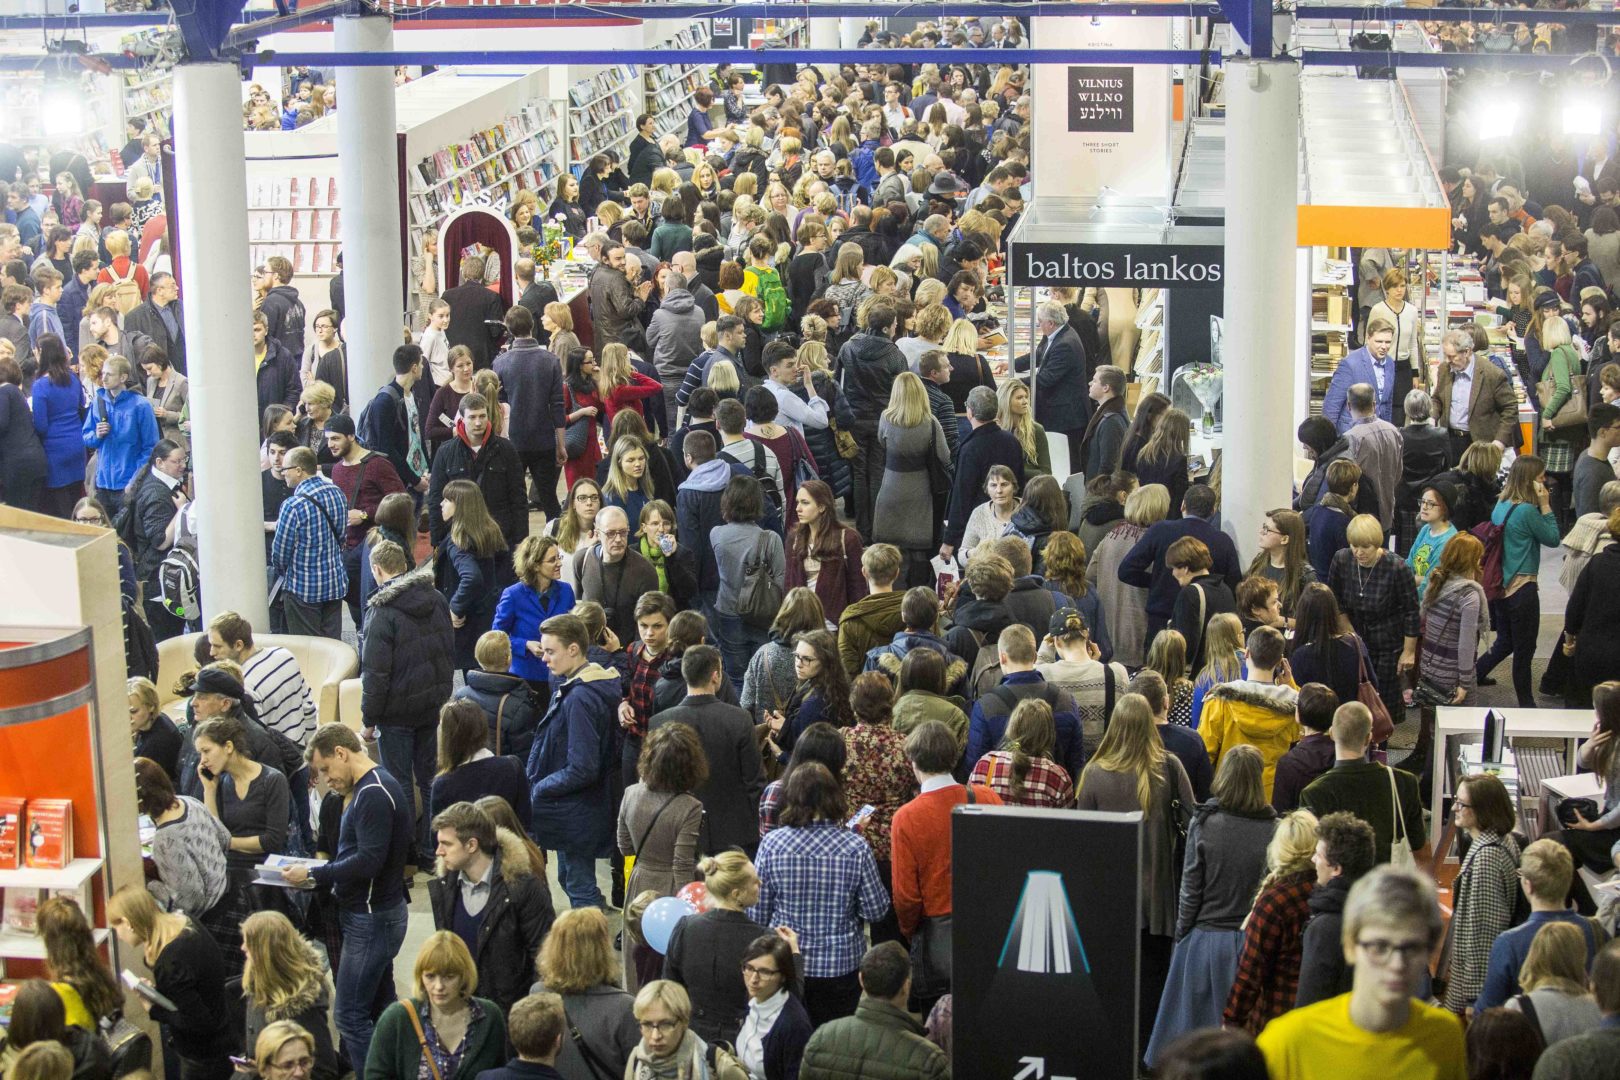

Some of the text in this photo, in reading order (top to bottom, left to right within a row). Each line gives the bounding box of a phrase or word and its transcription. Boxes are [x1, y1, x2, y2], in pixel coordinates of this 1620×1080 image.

[1078, 79, 1123, 88] VILNIUS
[1078, 93, 1123, 102] WILNO
[440, 189, 508, 218] KASA
[1026, 253, 1221, 281] baltos lankos
